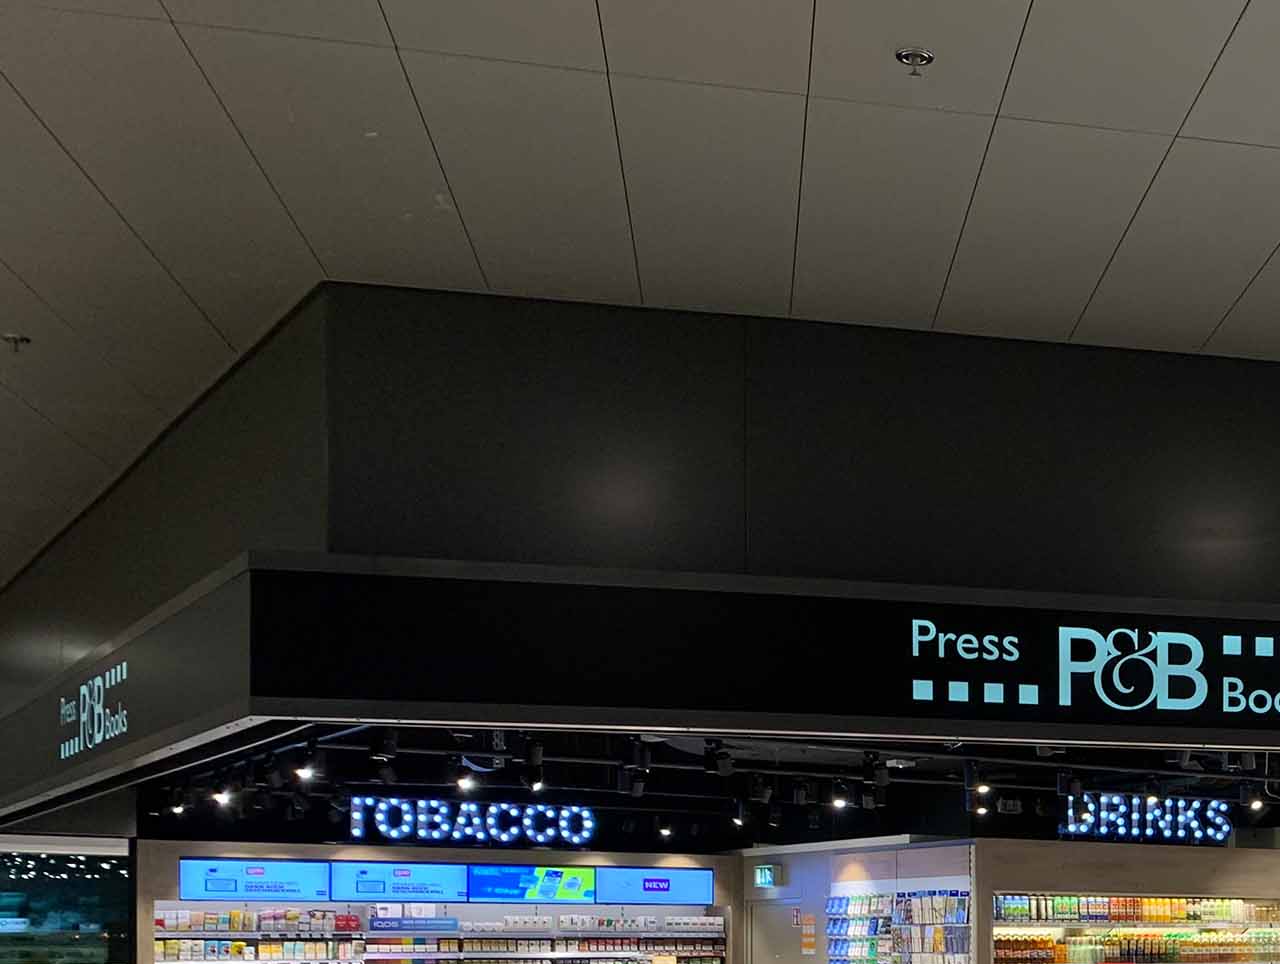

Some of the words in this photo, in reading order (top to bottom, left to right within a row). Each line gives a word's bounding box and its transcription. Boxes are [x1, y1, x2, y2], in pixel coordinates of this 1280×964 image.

[912, 619, 1020, 661] Press
[1058, 626, 1208, 710] P&B
[350, 796, 595, 844] TOBACCO
[1065, 794, 1233, 841] DRINKS
[644, 881, 670, 890] NEW
